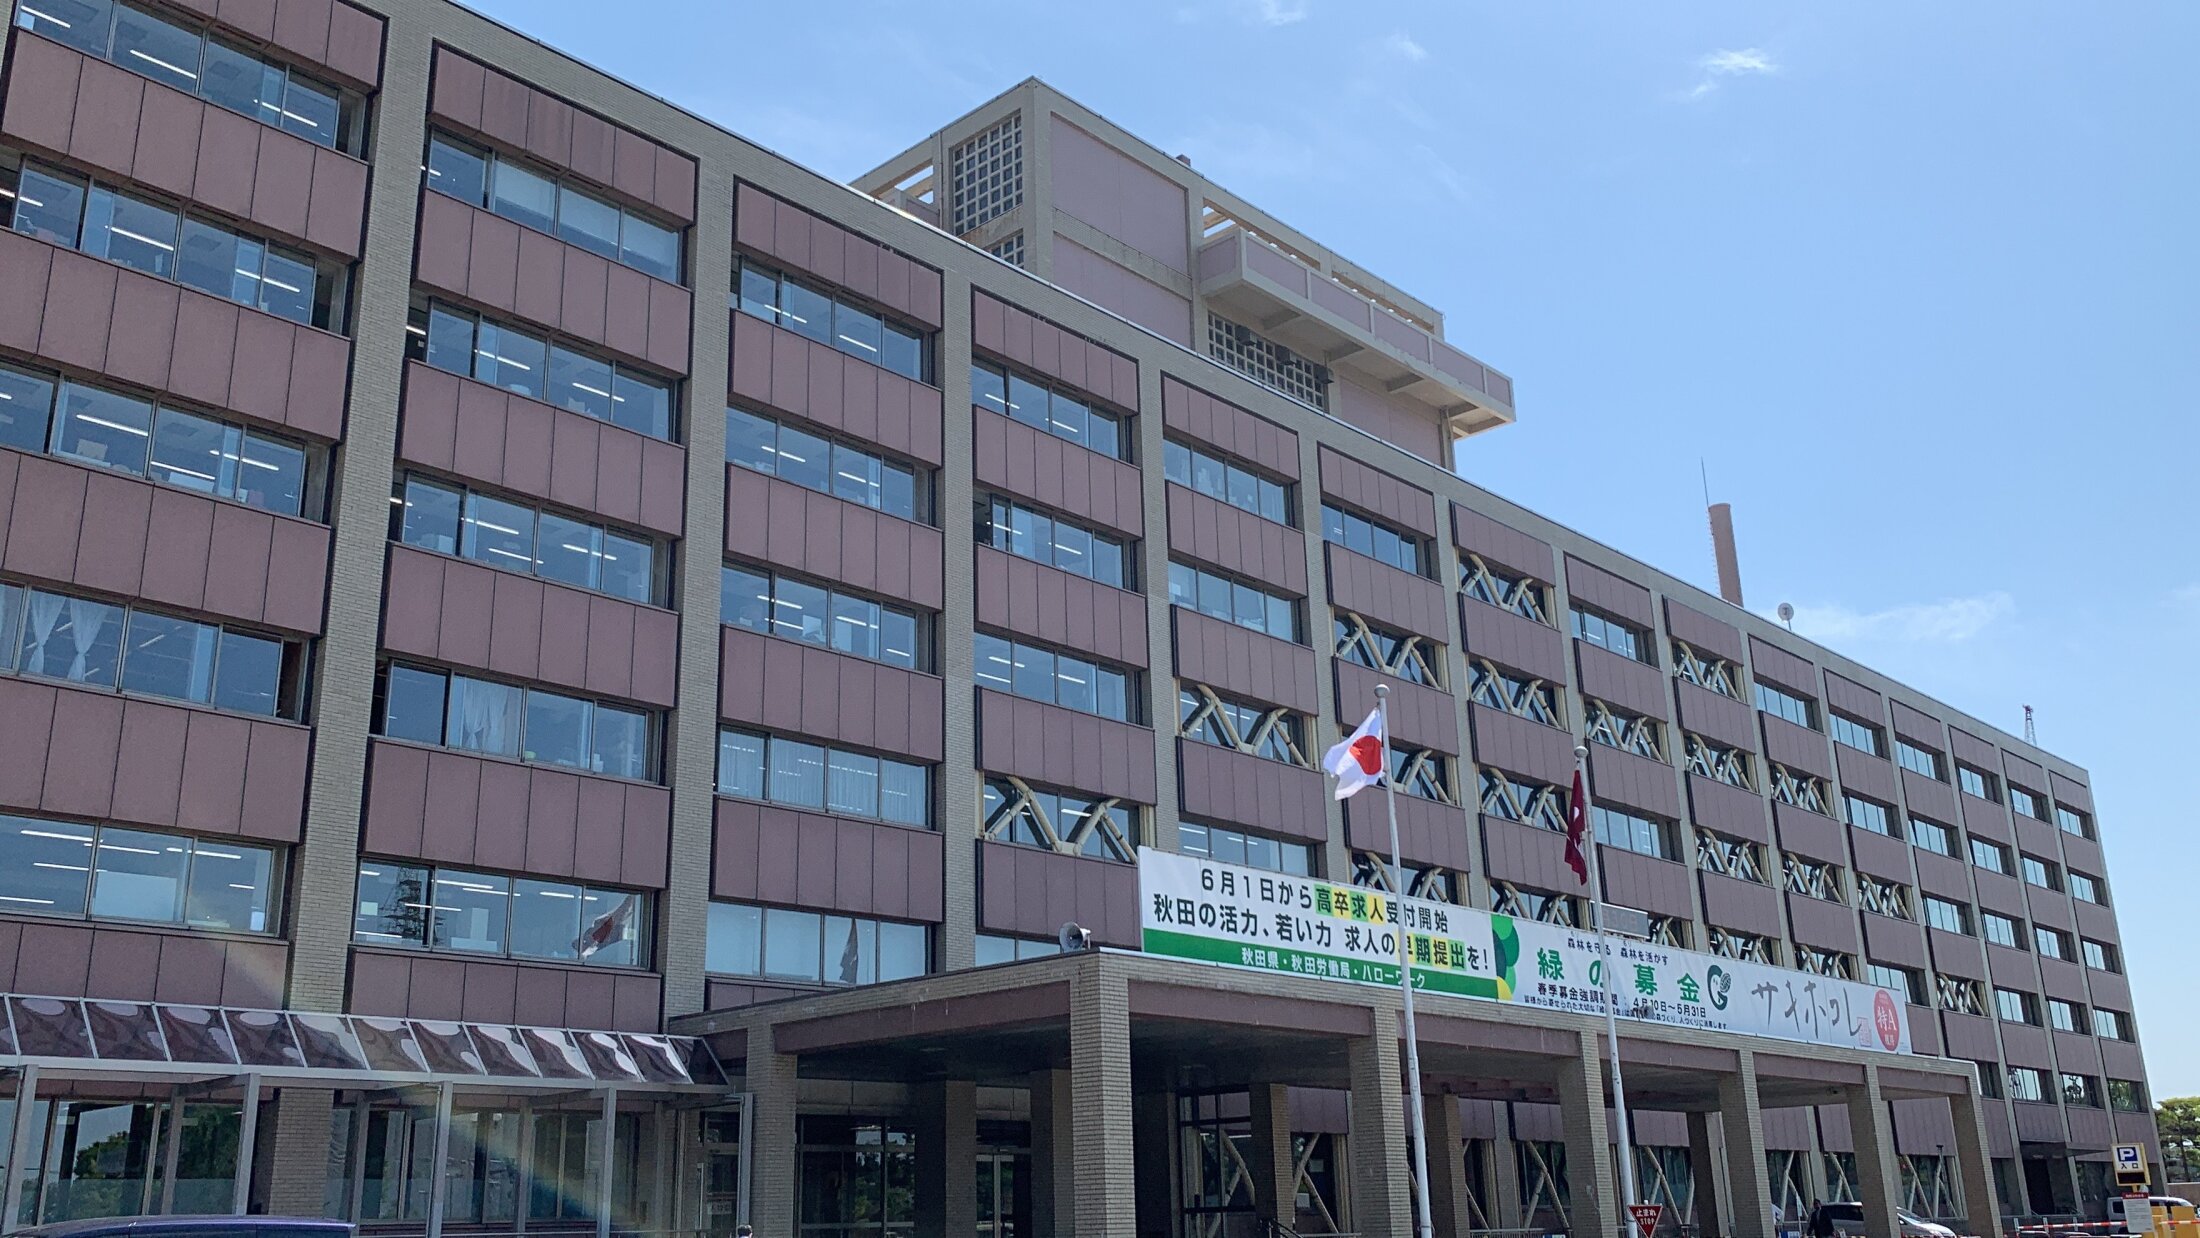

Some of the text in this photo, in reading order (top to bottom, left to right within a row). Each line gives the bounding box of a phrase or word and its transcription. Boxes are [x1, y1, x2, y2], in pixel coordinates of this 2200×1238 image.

[1201, 867, 1449, 934] 6月1日から高卒求人受付開始
[2120, 1148, 2135, 1160] P
[1636, 1208, 1656, 1216] 止まれ
[1640, 1217, 1655, 1225] STOP
